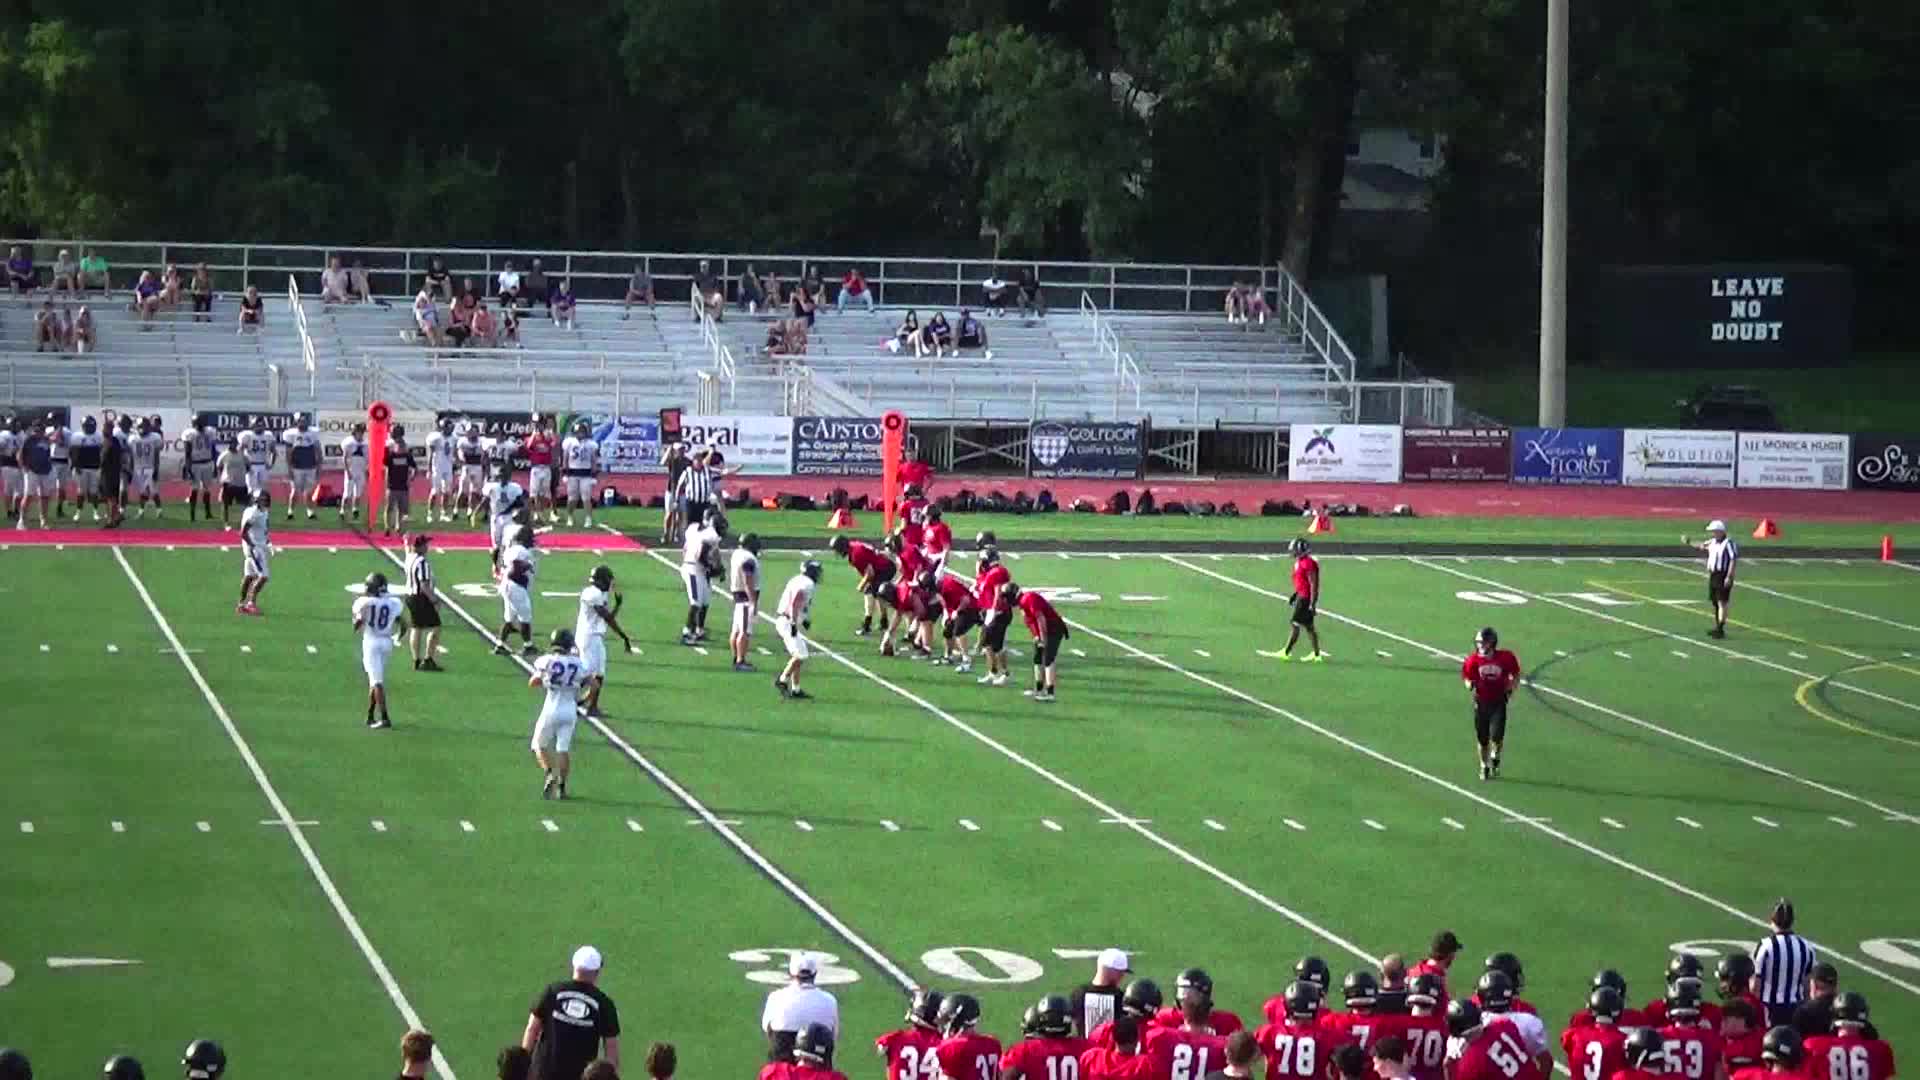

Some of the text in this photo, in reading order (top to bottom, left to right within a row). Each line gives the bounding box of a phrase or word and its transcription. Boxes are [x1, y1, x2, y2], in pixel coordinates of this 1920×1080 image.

[1711, 278, 1784, 296] LEAVE
[1730, 300, 1761, 318] NO
[1711, 322, 1783, 340] DOUBT
[368, 604, 390, 631] 18
[549, 661, 578, 687] 27
[900, 1046, 942, 1080] 34
[1171, 1043, 1209, 1080] 21
[1275, 1033, 1316, 1076] 78
[1407, 1028, 1443, 1068] 70
[1487, 1031, 1529, 1078] 51
[1584, 1041, 1603, 1080] 3
[1664, 1039, 1703, 1078] 53
[1828, 1045, 1870, 1080] 86
